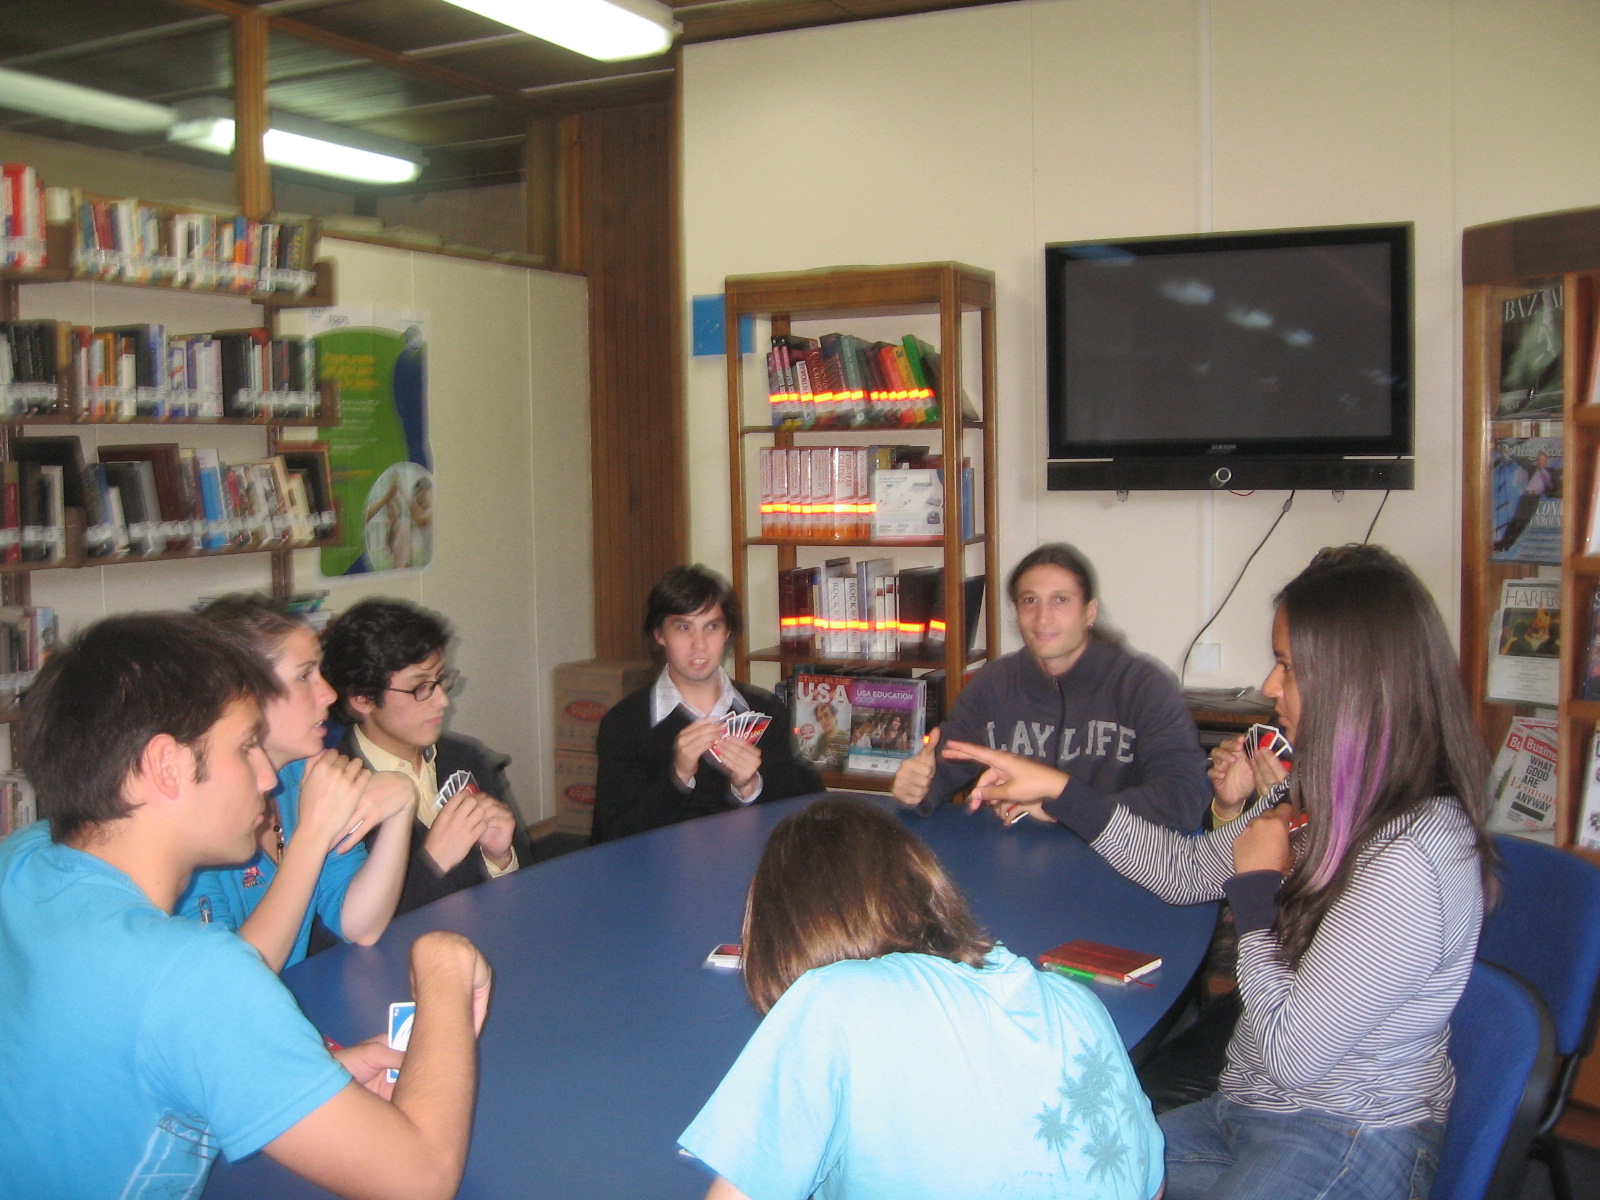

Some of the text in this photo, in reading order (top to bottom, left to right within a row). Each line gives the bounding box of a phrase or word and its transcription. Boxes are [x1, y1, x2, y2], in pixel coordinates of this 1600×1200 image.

[797, 682, 850, 704] USA
[873, 691, 914, 700] EDUCATION
[1060, 719, 1137, 762] LIFE
[1530, 755, 1553, 773] WHAT
[1521, 774, 1540, 789] ARE
[1526, 765, 1548, 782] GOOD
[1515, 791, 1551, 812] ANYWAY
[393, 1008, 400, 1017] 2
